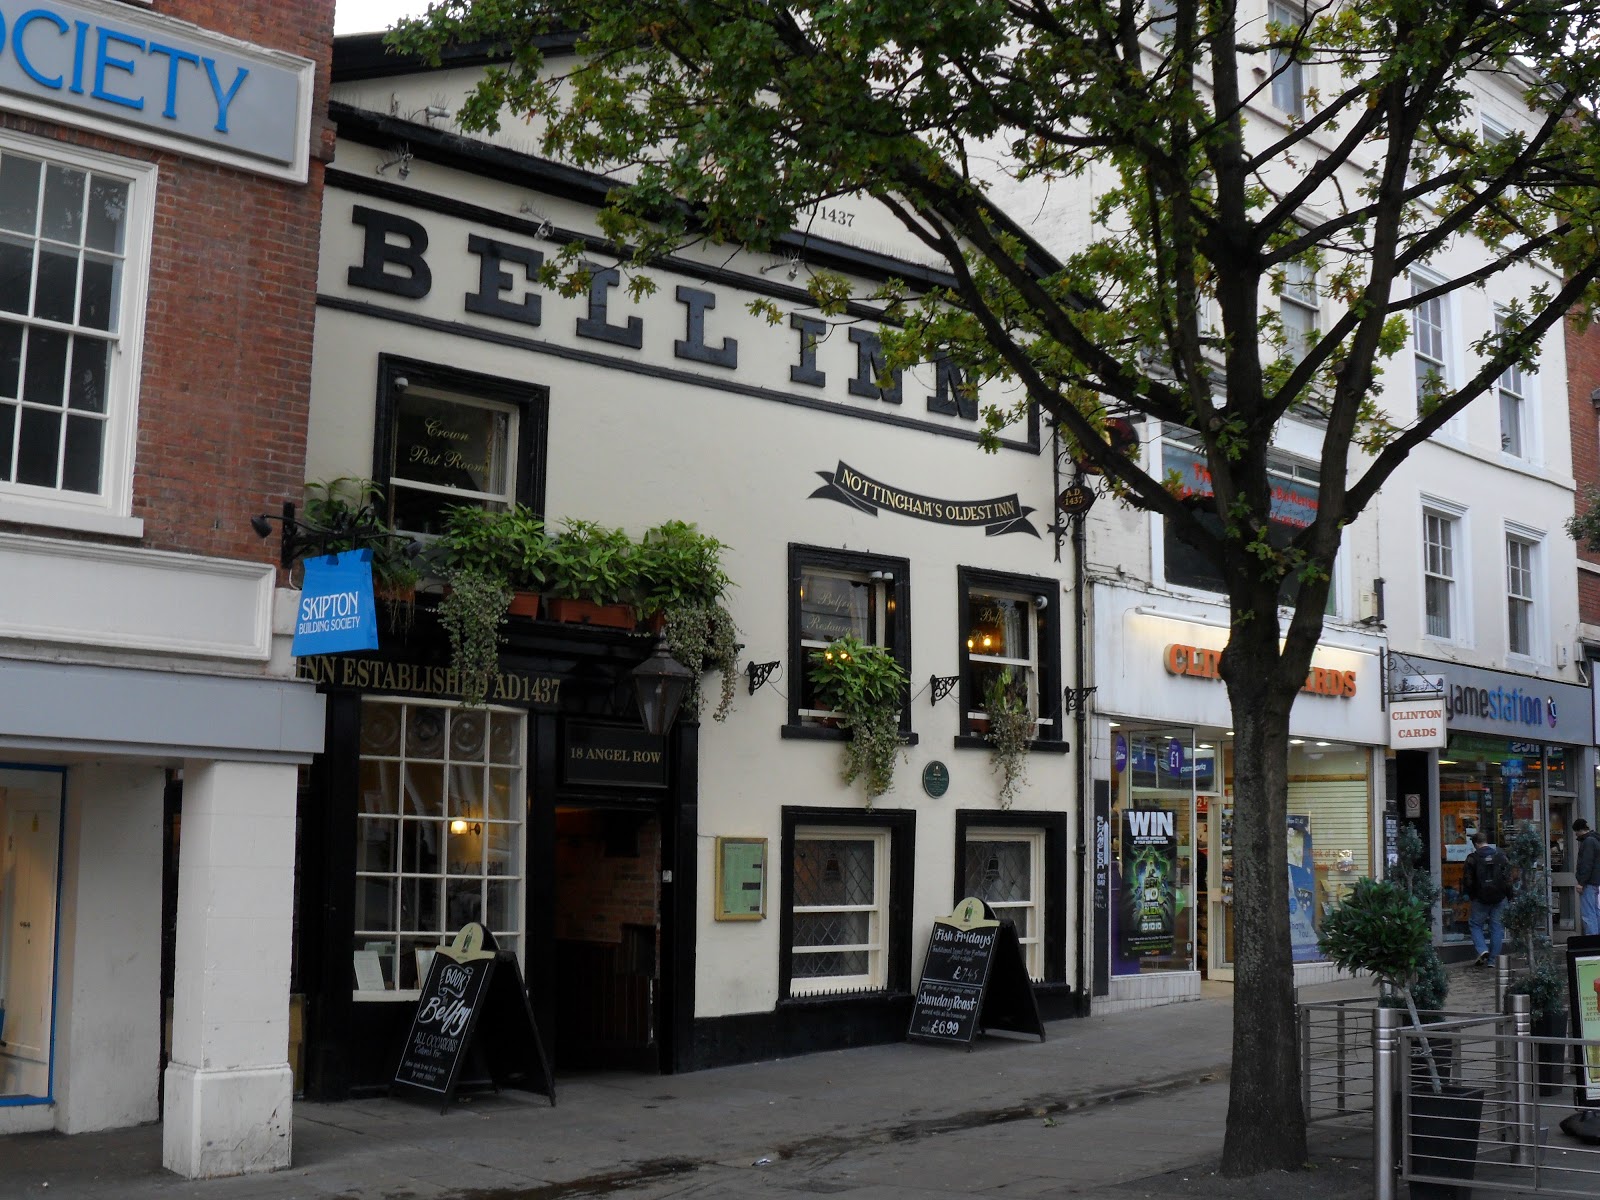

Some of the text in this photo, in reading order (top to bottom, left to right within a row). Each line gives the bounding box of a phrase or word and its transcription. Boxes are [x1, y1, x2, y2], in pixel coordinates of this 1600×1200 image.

[0, 9, 249, 134] CIETY
[820, 206, 855, 227] 1437
[347, 203, 980, 421] BELL INN
[424, 417, 470, 441] Crown
[409, 445, 485, 473] Post Room
[841, 468, 1015, 521] NOTTINGHAM'S OLDEST INN
[1065, 496, 1084, 505] 1437
[302, 591, 358, 621] SKIPTON
[299, 616, 360, 634] BUILDING SOCIETY
[342, 658, 489, 696] ESTABLISHED
[1300, 666, 1357, 698] ARDS
[1392, 709, 1442, 721] CLINTON
[1446, 684, 1542, 725] gamestation
[1398, 728, 1437, 738] CARDS
[570, 747, 662, 763] 18 ANGEL ROW
[1128, 811, 1174, 836] WIN
[934, 928, 995, 949] Fish Fridays
[445, 968, 468, 991] BOOK
[918, 991, 954, 1011] Sunday
[952, 995, 977, 1012] Roast
[417, 996, 474, 1037] Belfry
[930, 1019, 959, 1036] £6.99
